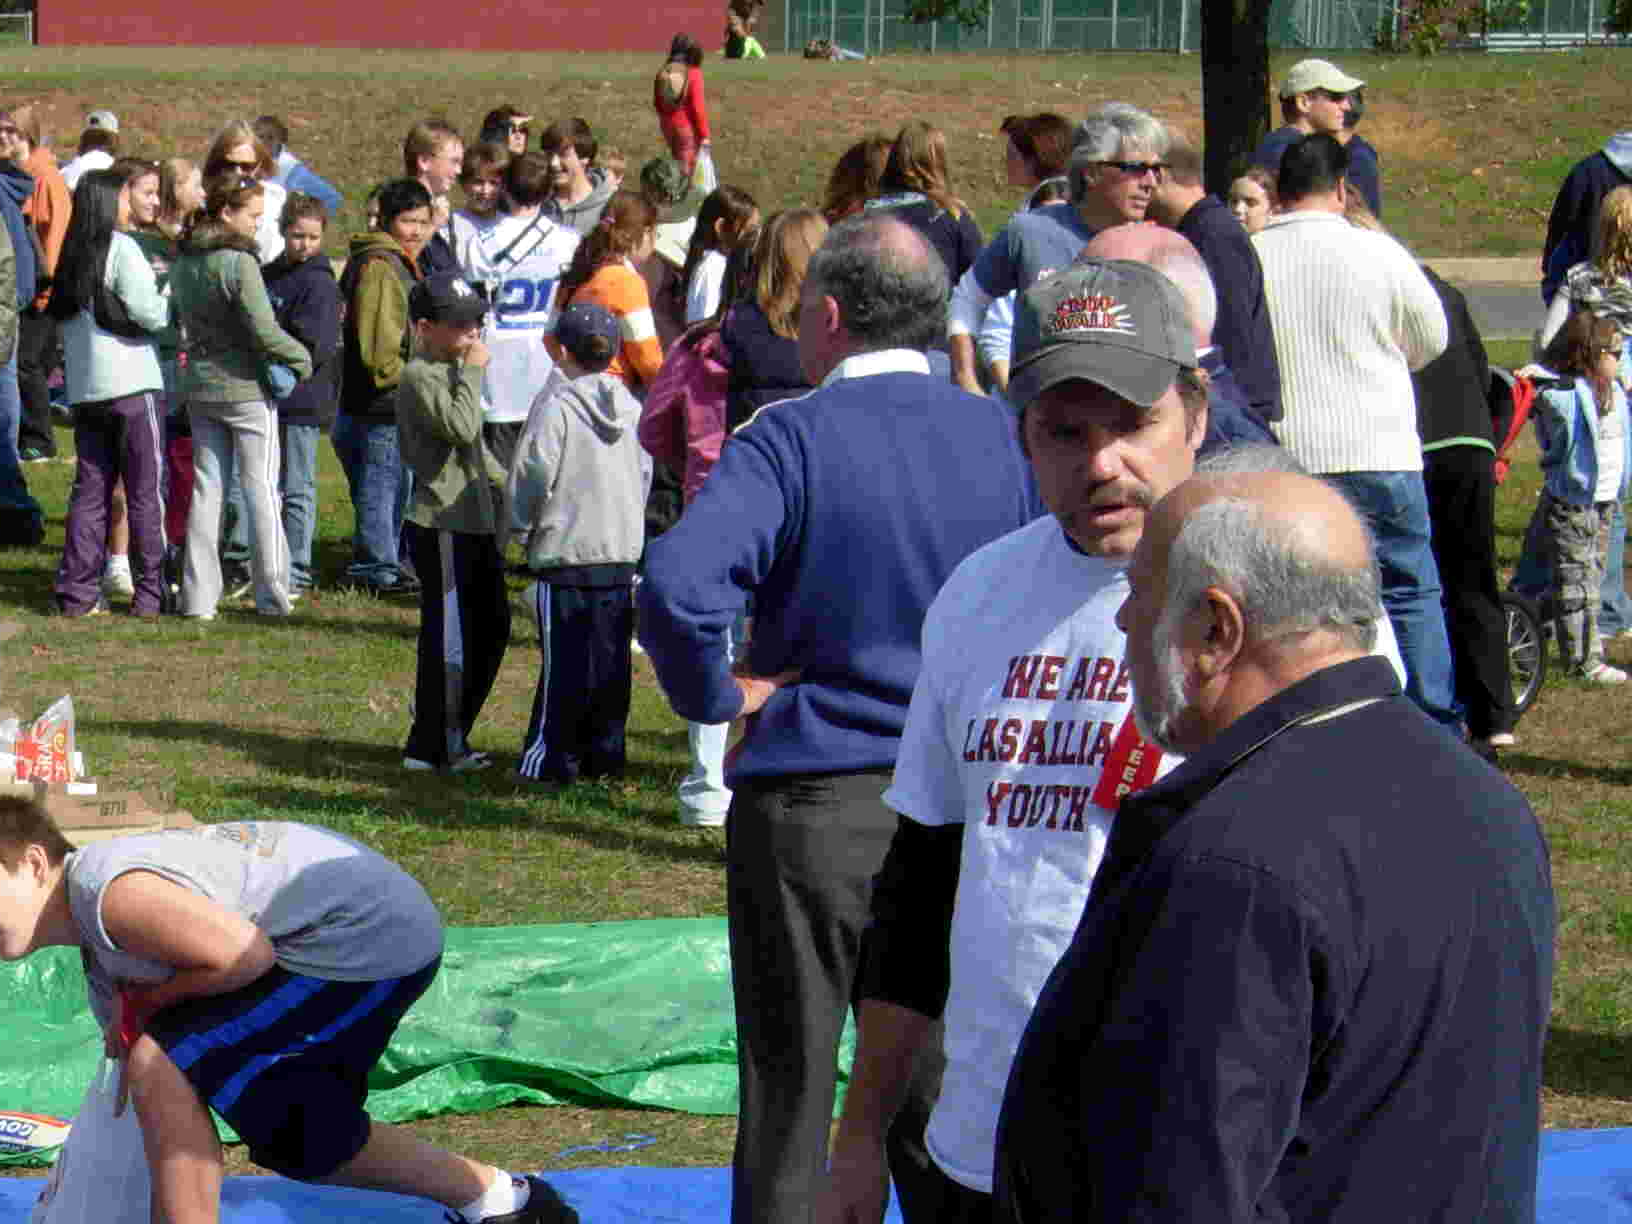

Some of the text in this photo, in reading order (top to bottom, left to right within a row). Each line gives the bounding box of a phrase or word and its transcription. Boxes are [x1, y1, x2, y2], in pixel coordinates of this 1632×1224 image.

[1002, 655, 1130, 703] WE ARE
[963, 717, 1116, 766] LASALLIA
[986, 781, 1092, 833] YOUTH
